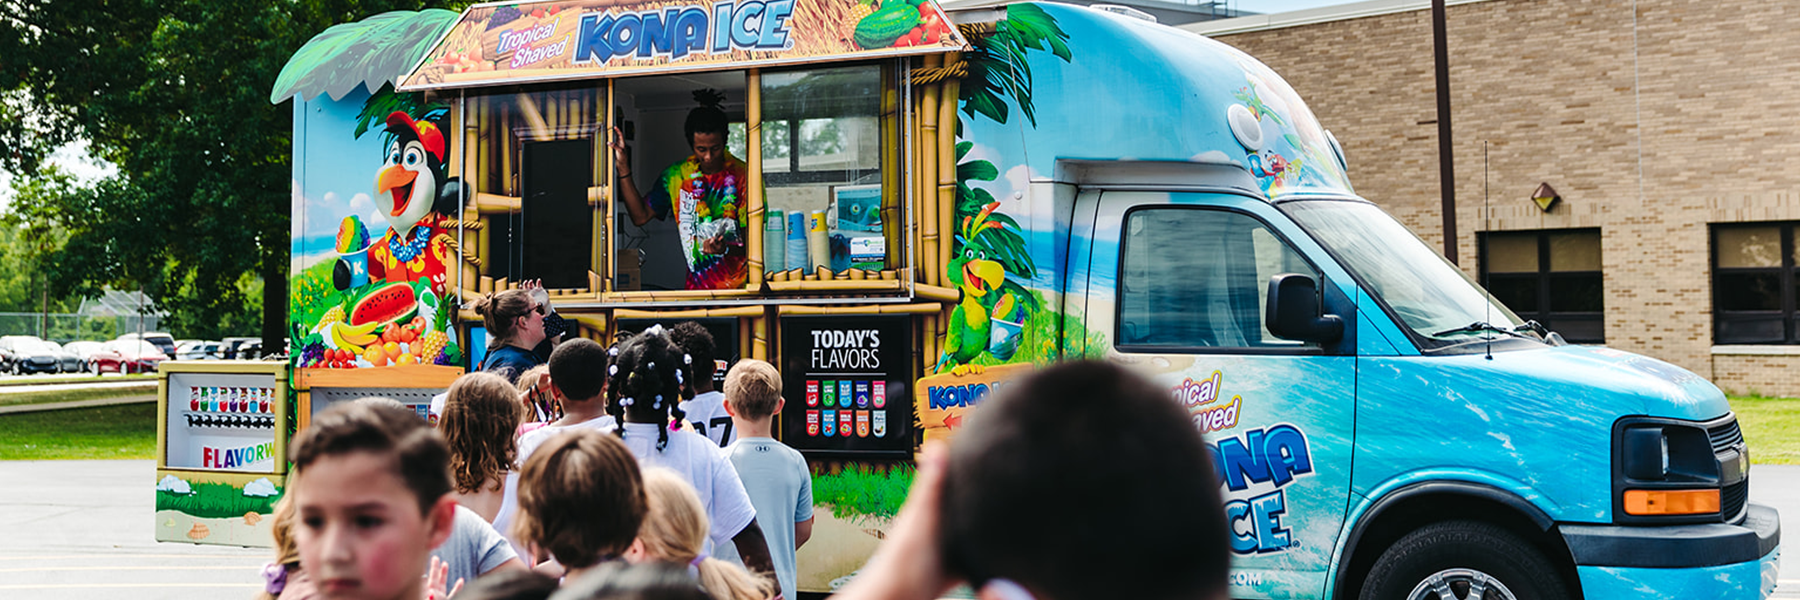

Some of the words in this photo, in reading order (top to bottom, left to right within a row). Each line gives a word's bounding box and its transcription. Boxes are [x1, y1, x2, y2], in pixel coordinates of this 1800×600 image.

[498, 17, 560, 52] Tropical
[574, 7, 709, 65] KONA
[712, 0, 793, 52] ICE
[511, 34, 571, 68] Shaved
[353, 261, 364, 275] K
[811, 330, 880, 348] TODAY'S
[811, 349, 880, 369] FLAVORS
[1222, 489, 1292, 555] CE
